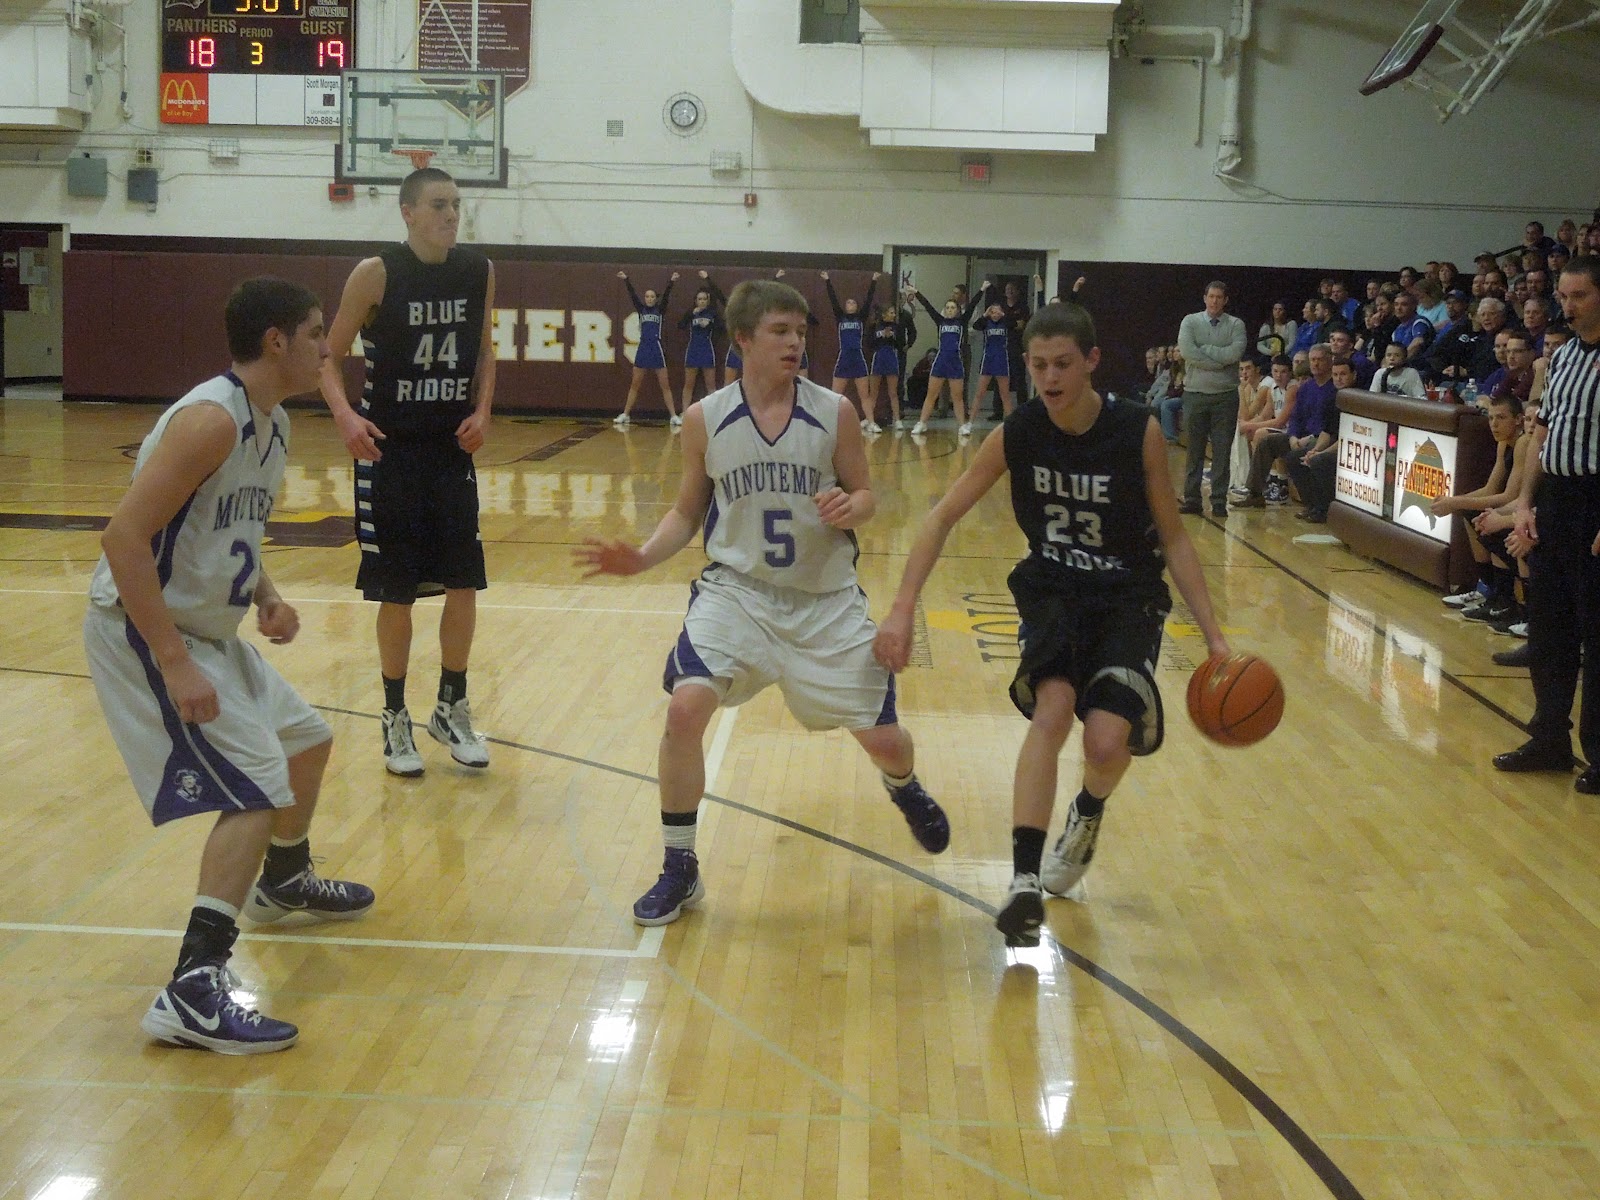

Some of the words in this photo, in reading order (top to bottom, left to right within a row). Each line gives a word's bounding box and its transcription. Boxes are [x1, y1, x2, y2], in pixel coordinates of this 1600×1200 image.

[309, 6, 348, 17] GYMNASIUM
[167, 18, 237, 34] PANTHERS
[240, 28, 273, 38] PERIOD
[301, 20, 345, 35] GUEST
[190, 38, 215, 66] 18
[251, 42, 263, 64] 3
[318, 40, 343, 67] 19
[307, 78, 320, 89] Scott
[408, 298, 468, 327] BLUE
[413, 332, 459, 371] 44
[396, 378, 470, 403] RIDGE
[1338, 438, 1384, 481] LEROY
[1032, 465, 1111, 504] BLUE
[1337, 476, 1353, 497] HIGH
[1354, 482, 1380, 507] SCHOOL
[1397, 459, 1451, 498] PANTHERS
[763, 508, 796, 568] 5
[1044, 503, 1103, 548] 23
[228, 540, 254, 607] 2
